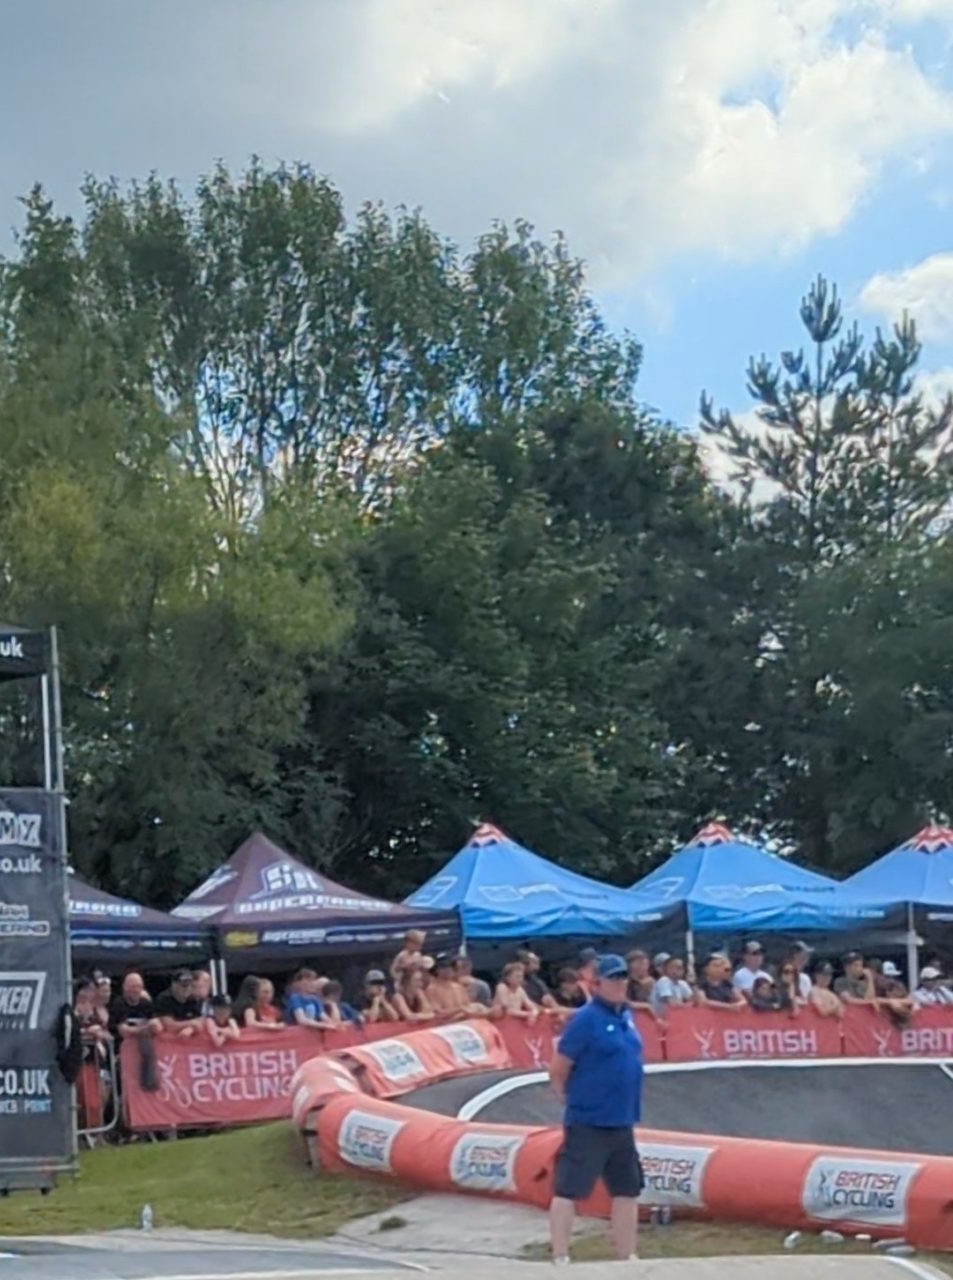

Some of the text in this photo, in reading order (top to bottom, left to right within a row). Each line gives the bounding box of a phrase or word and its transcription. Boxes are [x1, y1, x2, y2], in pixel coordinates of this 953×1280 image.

[725, 1030, 816, 1053] BRITISH
[188, 1050, 296, 1077] BRITISH
[644, 1174, 692, 1194] YCLING
[835, 1170, 901, 1189] BRITISH
[832, 1187, 895, 1209] CYCLING
